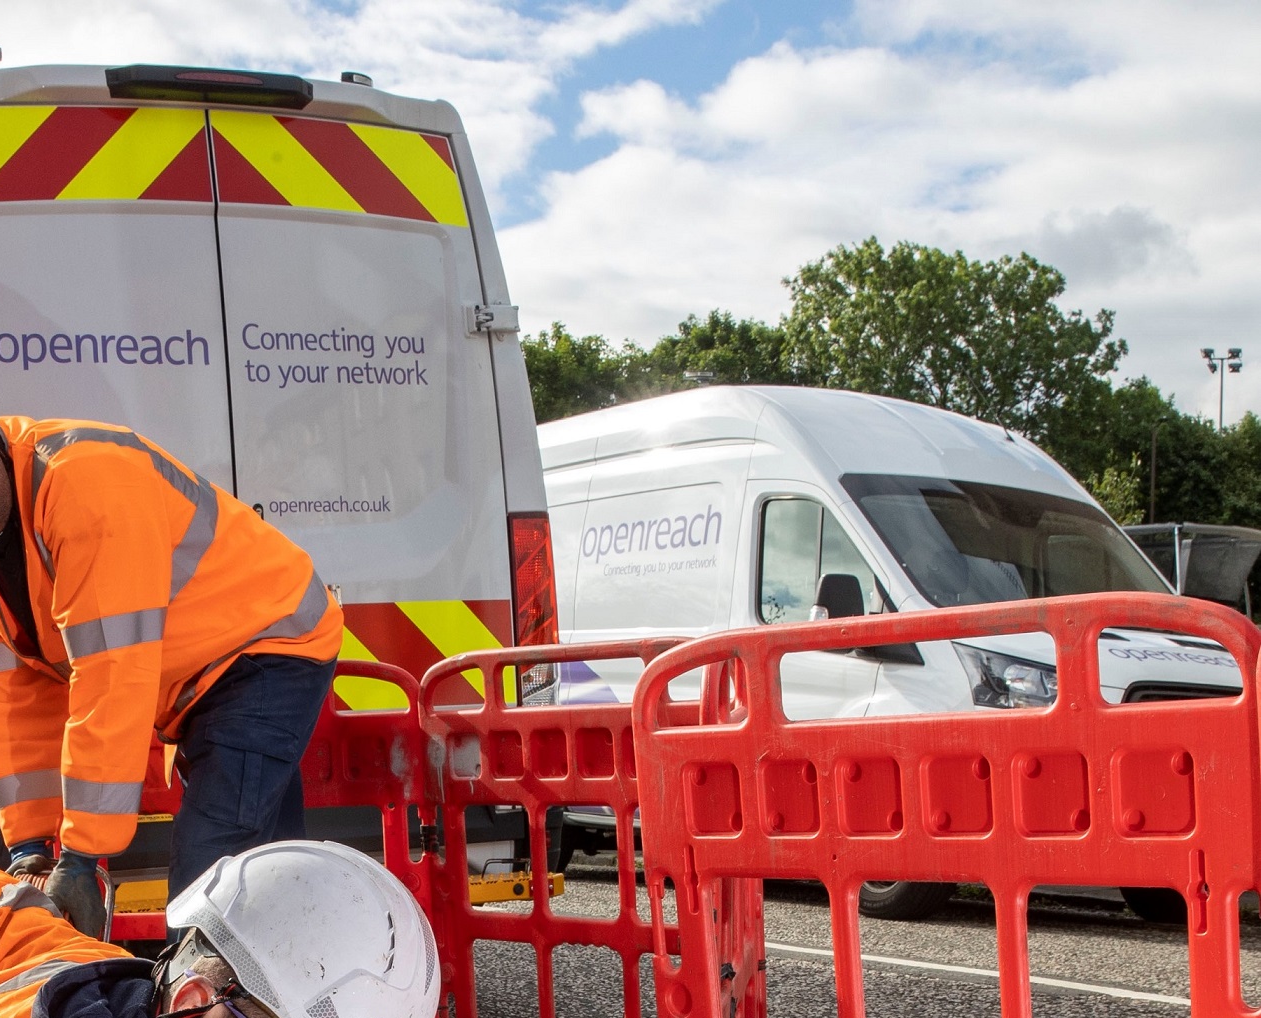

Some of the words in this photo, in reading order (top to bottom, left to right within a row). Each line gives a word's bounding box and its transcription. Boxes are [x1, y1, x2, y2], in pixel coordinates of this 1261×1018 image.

[242, 323, 375, 359] Connecting
[384, 335, 425, 359] you
[244, 359, 271, 383] to
[277, 363, 330, 389] your
[336, 359, 429, 386] network
[269, 495, 391, 517] openreach.co.uk
[582, 504, 722, 564] openreach
[603, 563, 641, 577] Connecting
[643, 562, 657, 576] you
[658, 561, 667, 572] to
[668, 560, 684, 574] your
[685, 555, 717, 570] network
[1108, 647, 1239, 669] openreac
